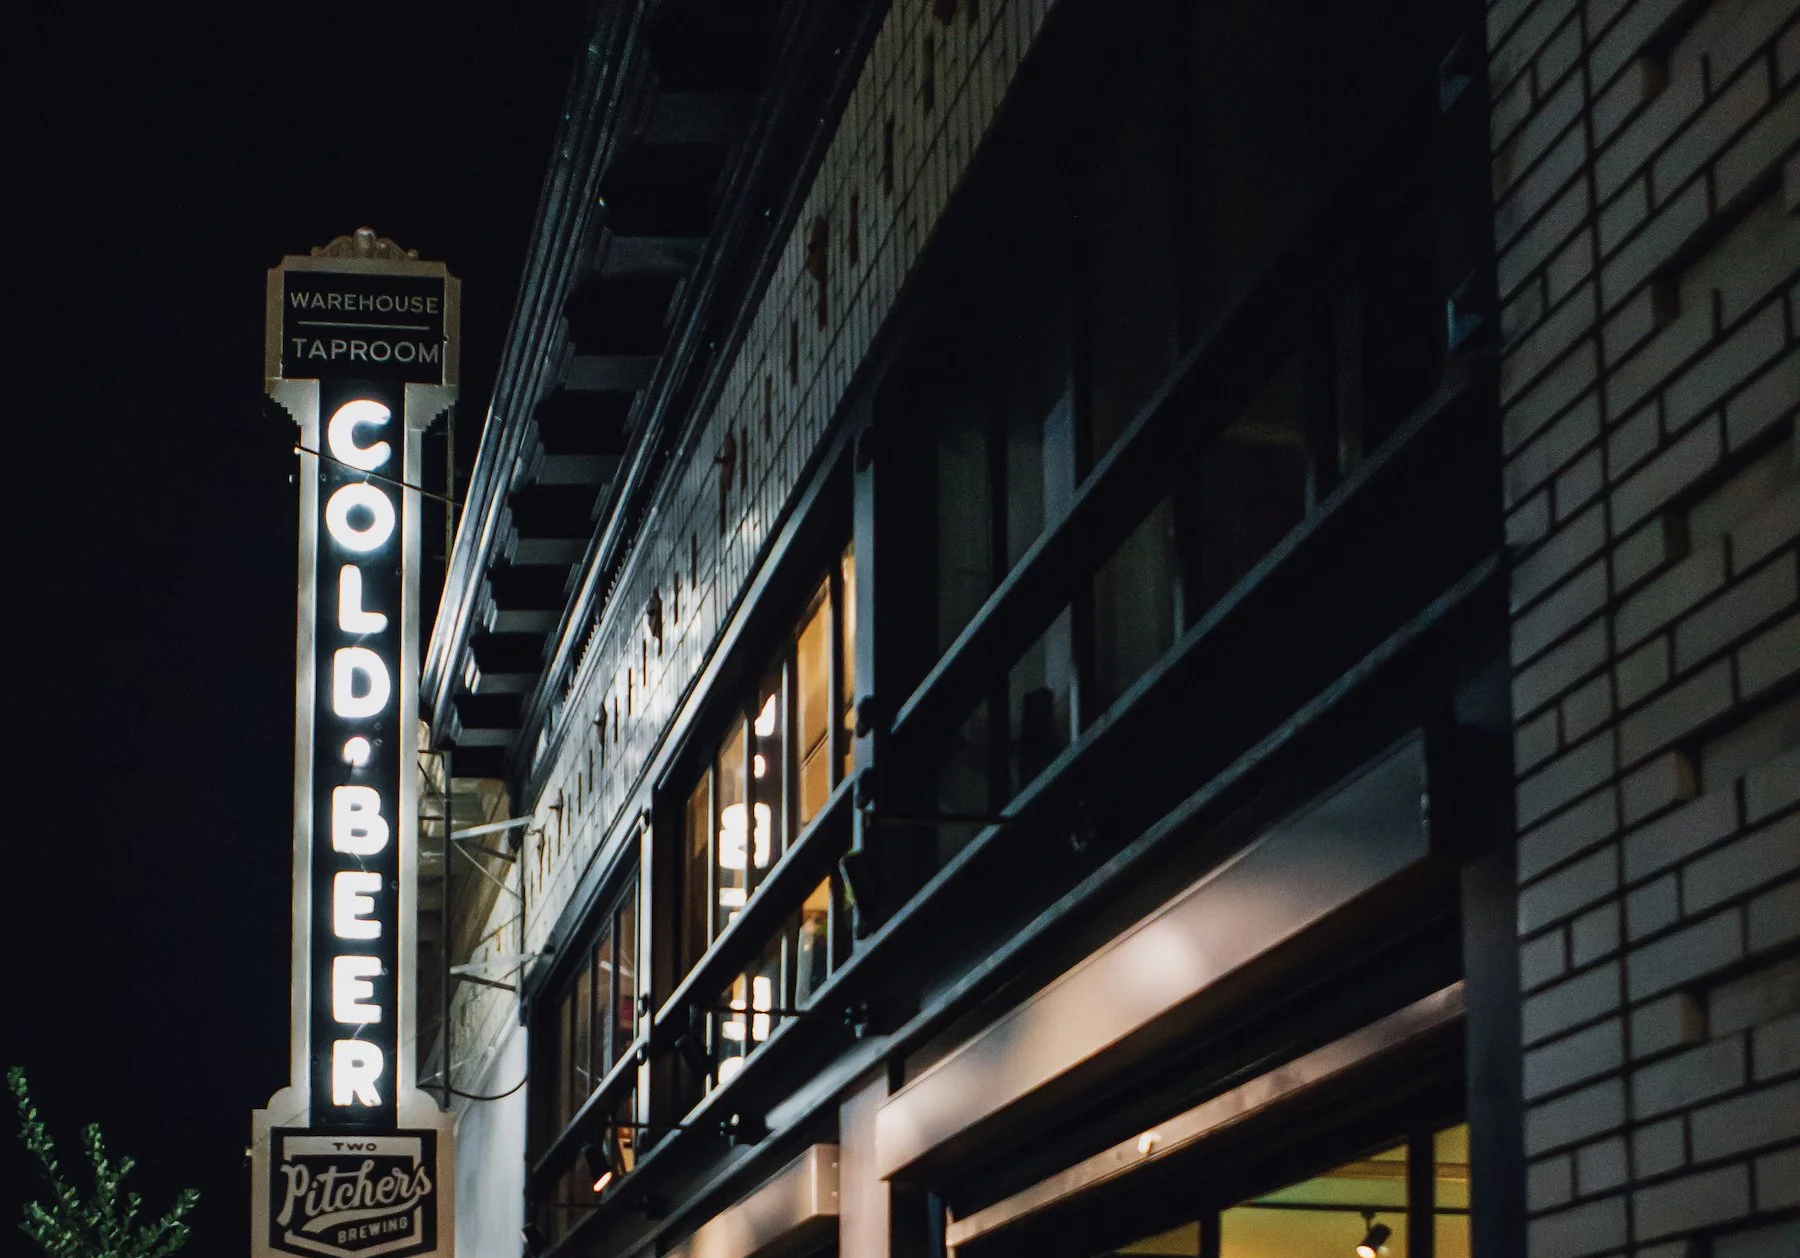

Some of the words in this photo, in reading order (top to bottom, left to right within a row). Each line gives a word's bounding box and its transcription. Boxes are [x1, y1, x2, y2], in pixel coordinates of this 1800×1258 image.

[290, 291, 438, 314] WAREHOUSE
[292, 337, 439, 364] TAPROOM
[326, 399, 396, 718] COLD
[332, 785, 390, 1107] BEER
[333, 1142, 377, 1152] TWO
[276, 1158, 432, 1227] Pitchers
[338, 1216, 408, 1245] BREWING
